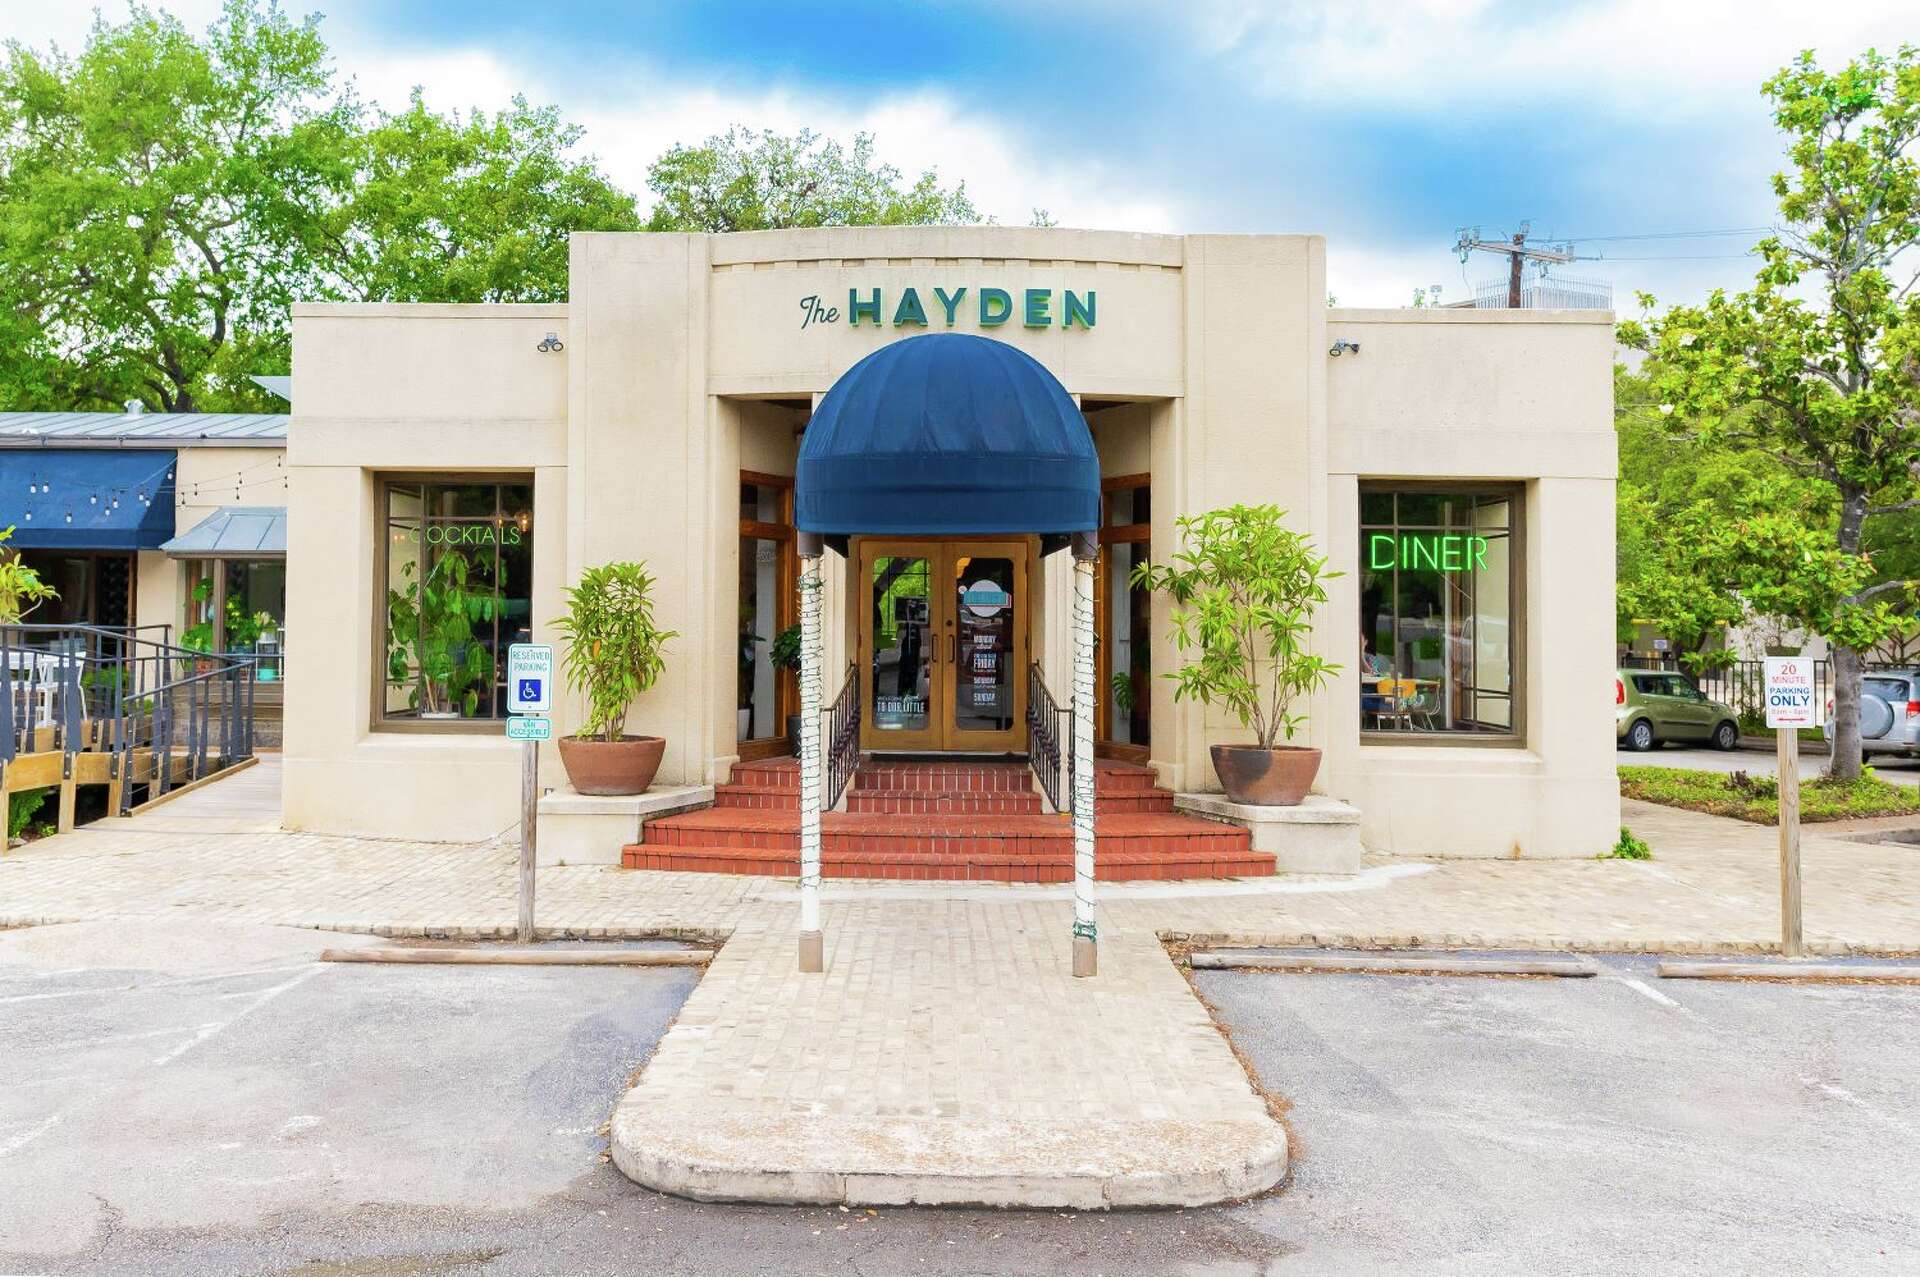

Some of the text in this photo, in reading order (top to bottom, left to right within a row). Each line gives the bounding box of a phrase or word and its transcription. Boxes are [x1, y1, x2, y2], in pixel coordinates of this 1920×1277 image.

[800, 287, 1098, 330] The HAYDEN
[408, 526, 520, 545] COCKTALS
[1370, 534, 1489, 571] DINER
[513, 650, 550, 661] RESERVED
[514, 662, 548, 672] PARKING
[974, 658, 996, 669] FRIDAY
[1781, 664, 1797, 675] 20
[1772, 676, 1807, 684] MINUTE
[1769, 687, 1810, 695] PARKING
[1770, 695, 1810, 706] ONLY
